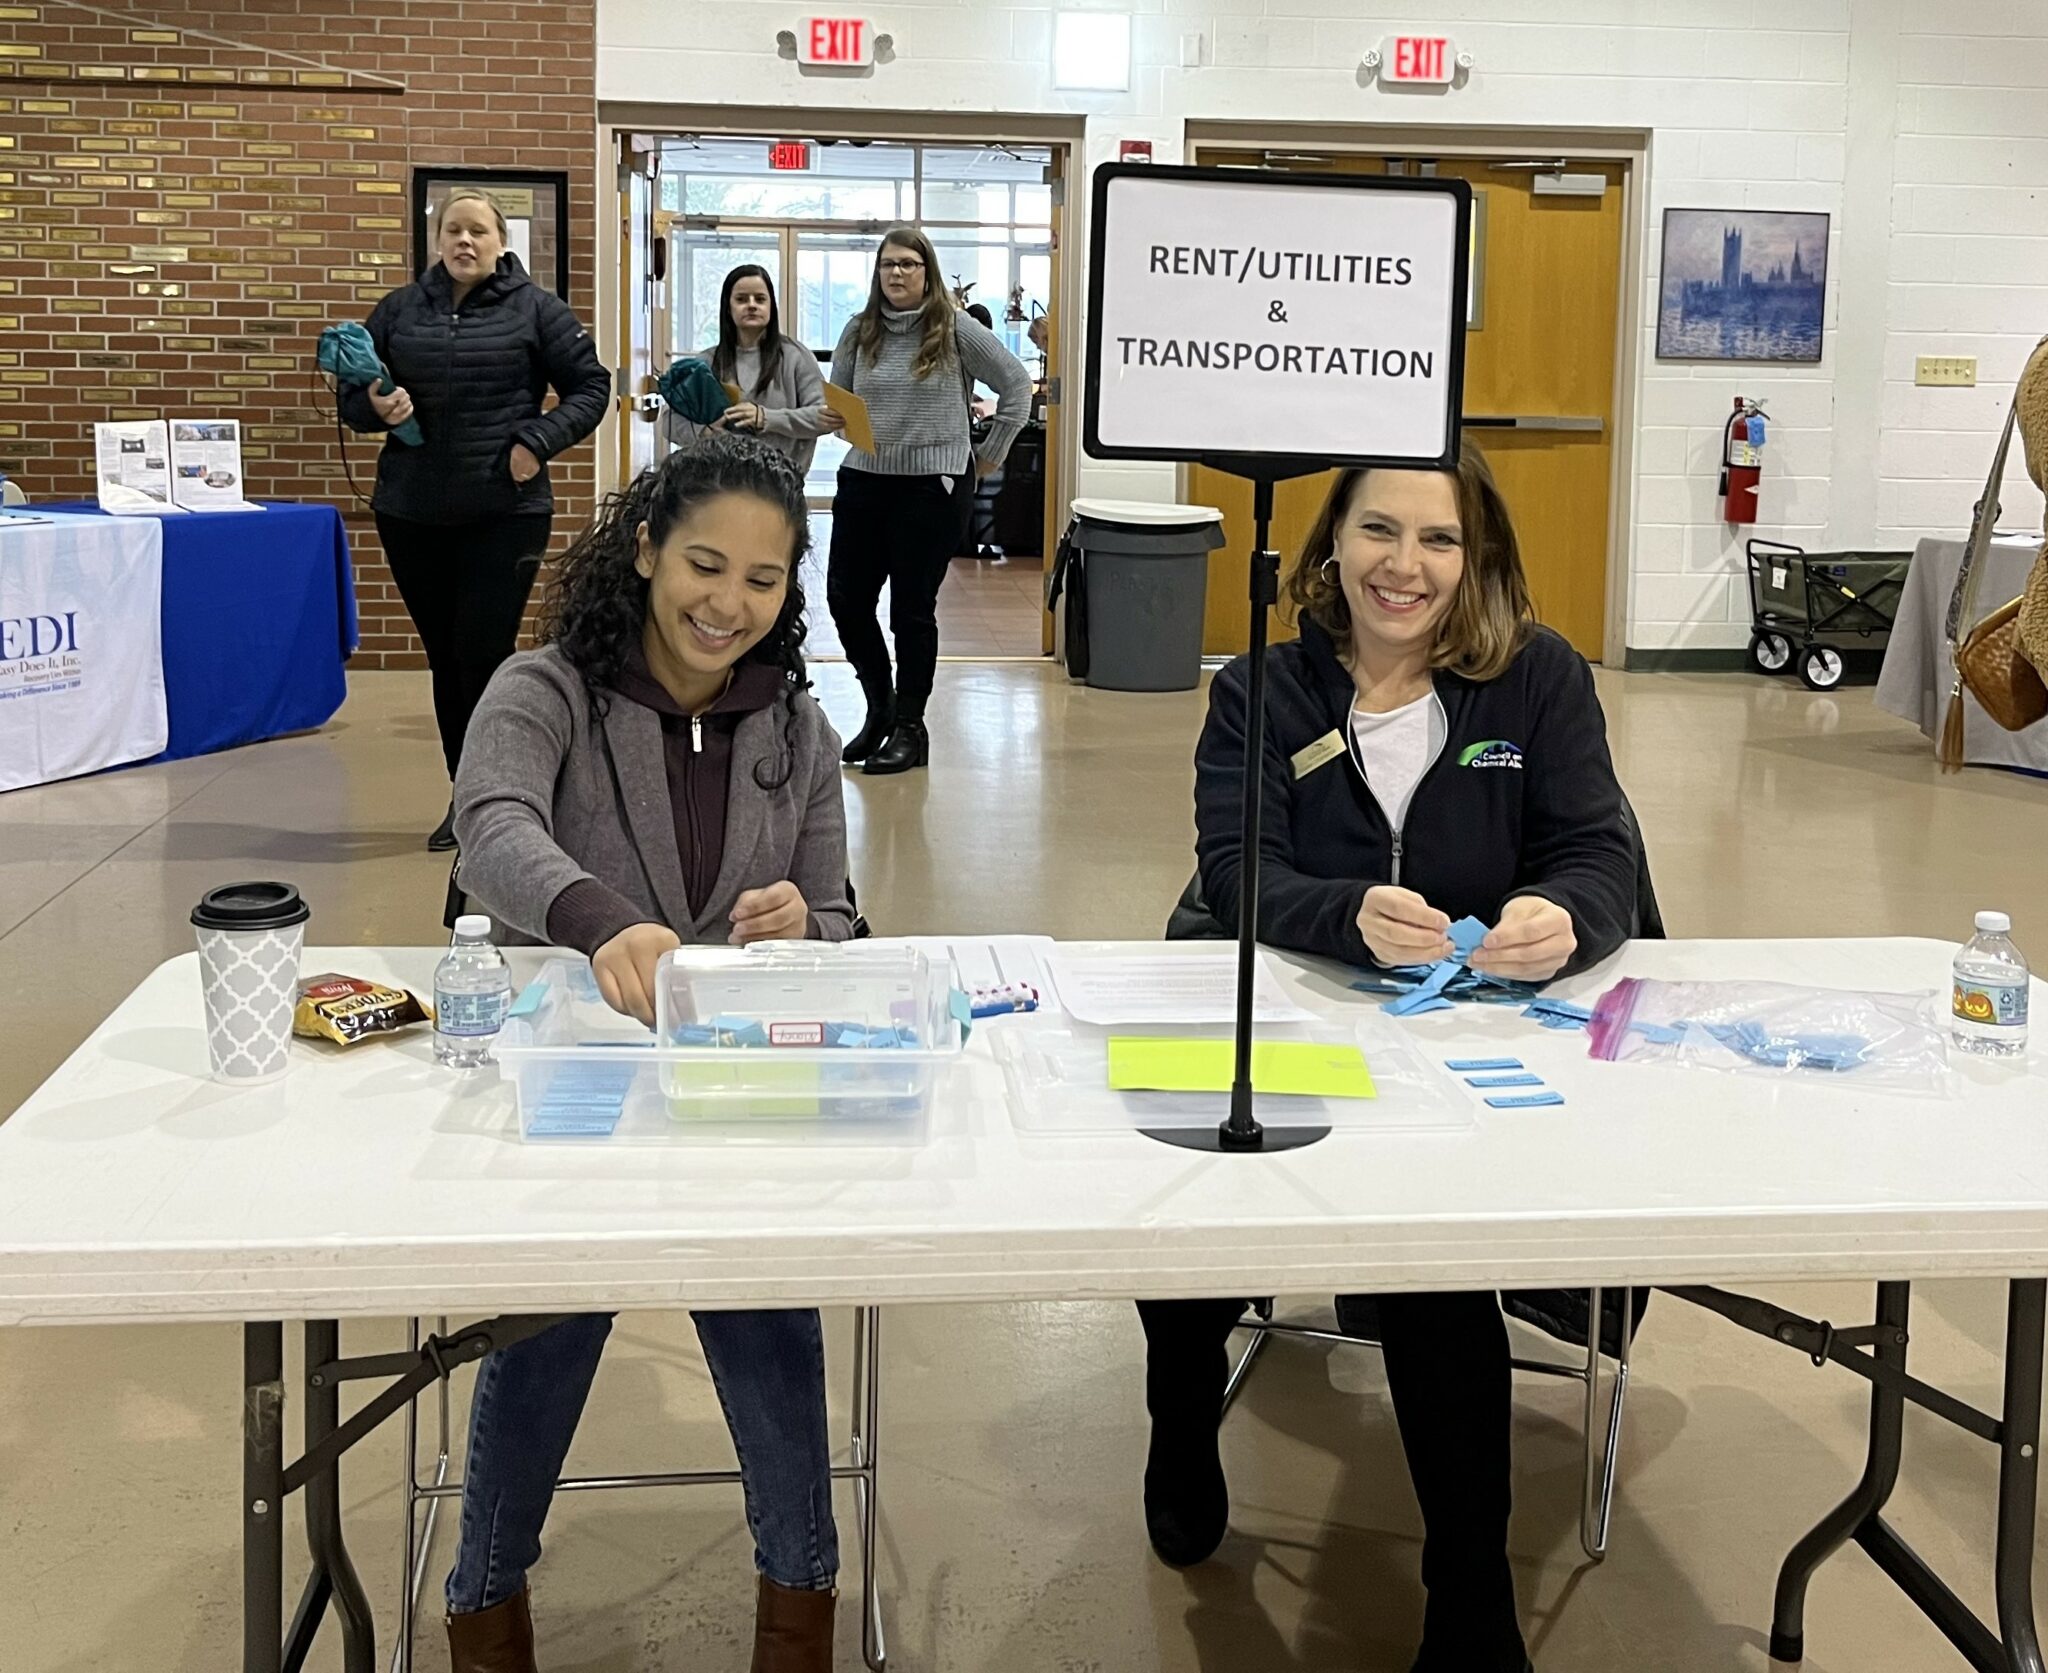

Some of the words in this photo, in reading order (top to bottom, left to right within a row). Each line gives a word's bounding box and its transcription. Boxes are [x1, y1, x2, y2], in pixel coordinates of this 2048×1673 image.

[810, 18, 864, 61] EXIT
[1395, 38, 1447, 80] EXIT
[775, 144, 806, 169] EXIT
[1149, 245, 1413, 286] RENT/UTILITIES
[1267, 299, 1289, 324] &
[1116, 336, 1434, 379] TRANSPORTATION
[0, 611, 80, 660] EDI
[20, 661, 46, 673] Does
[62, 655, 81, 667] Inc.
[1471, 759, 1507, 768] Chemical
[1483, 752, 1511, 760] Council
